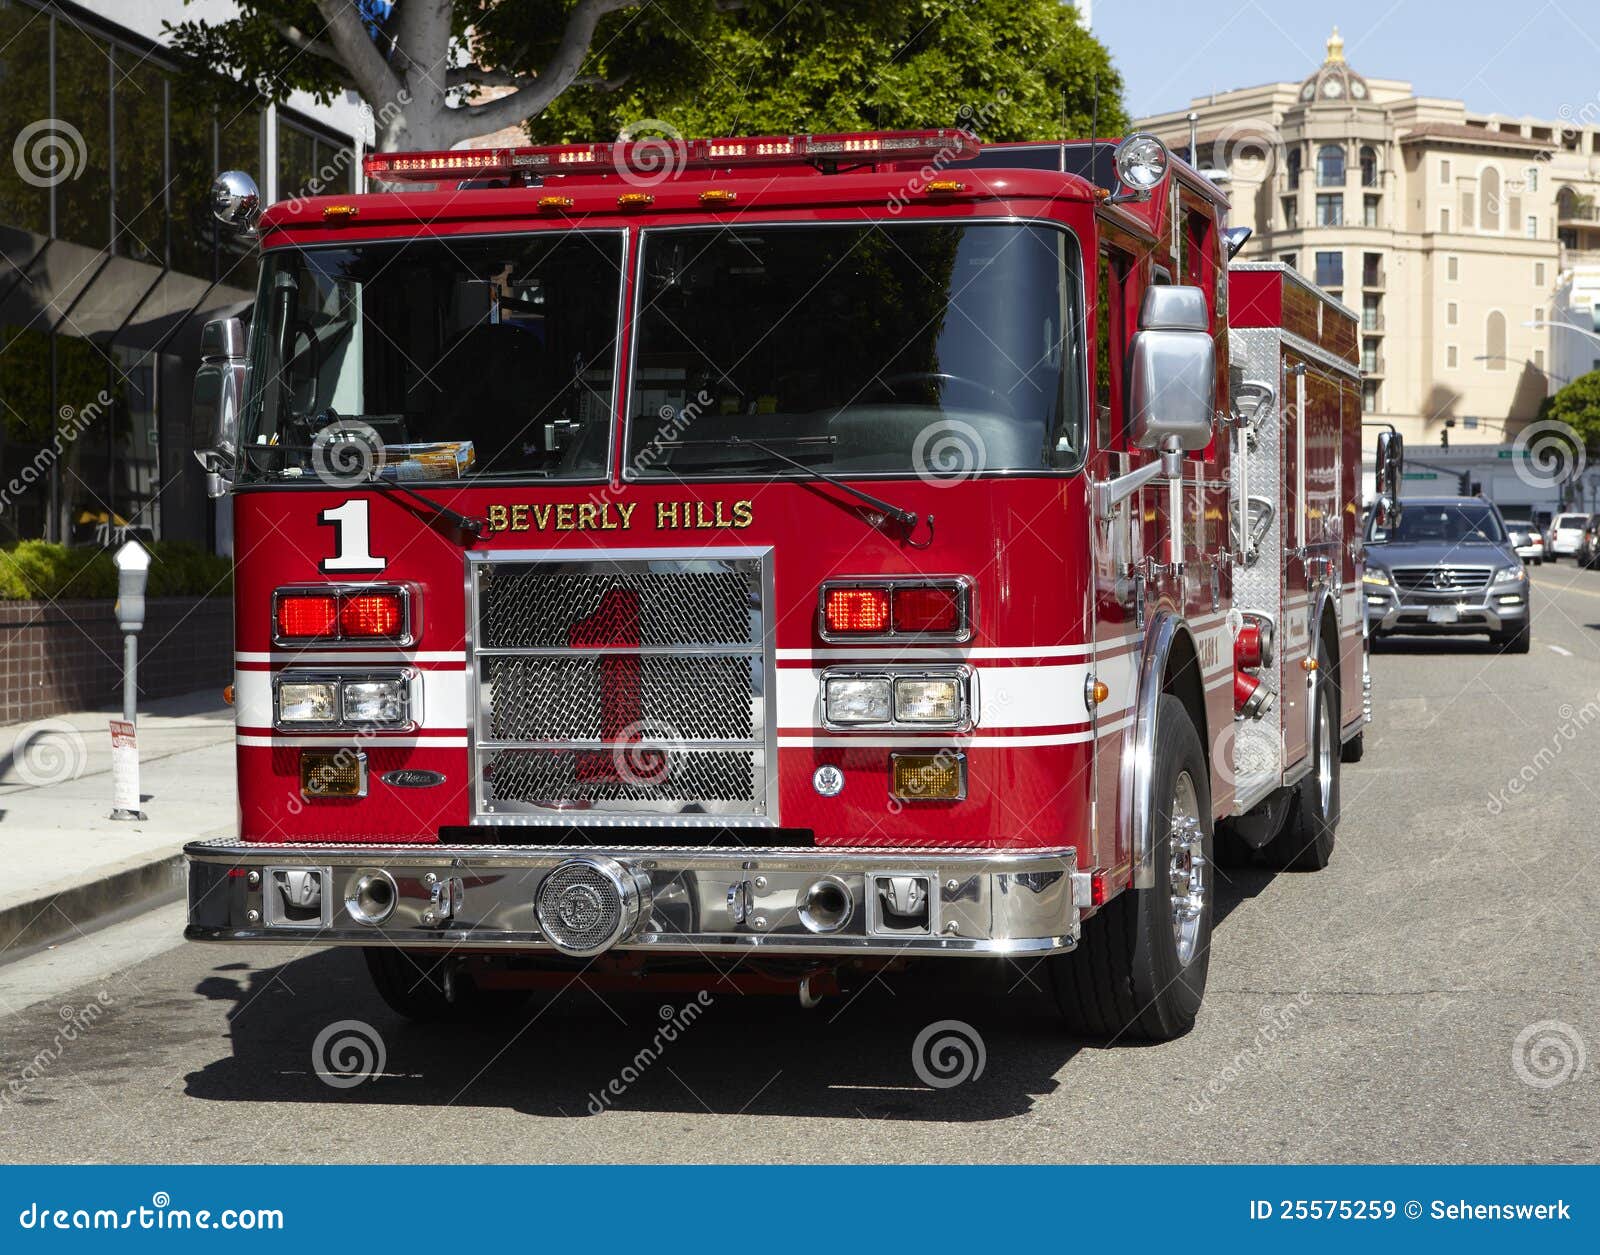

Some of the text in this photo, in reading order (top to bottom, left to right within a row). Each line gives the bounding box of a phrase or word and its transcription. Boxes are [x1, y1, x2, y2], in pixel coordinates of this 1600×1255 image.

[320, 499, 387, 572] 1
[487, 500, 754, 531] BEVERLY HILLS
